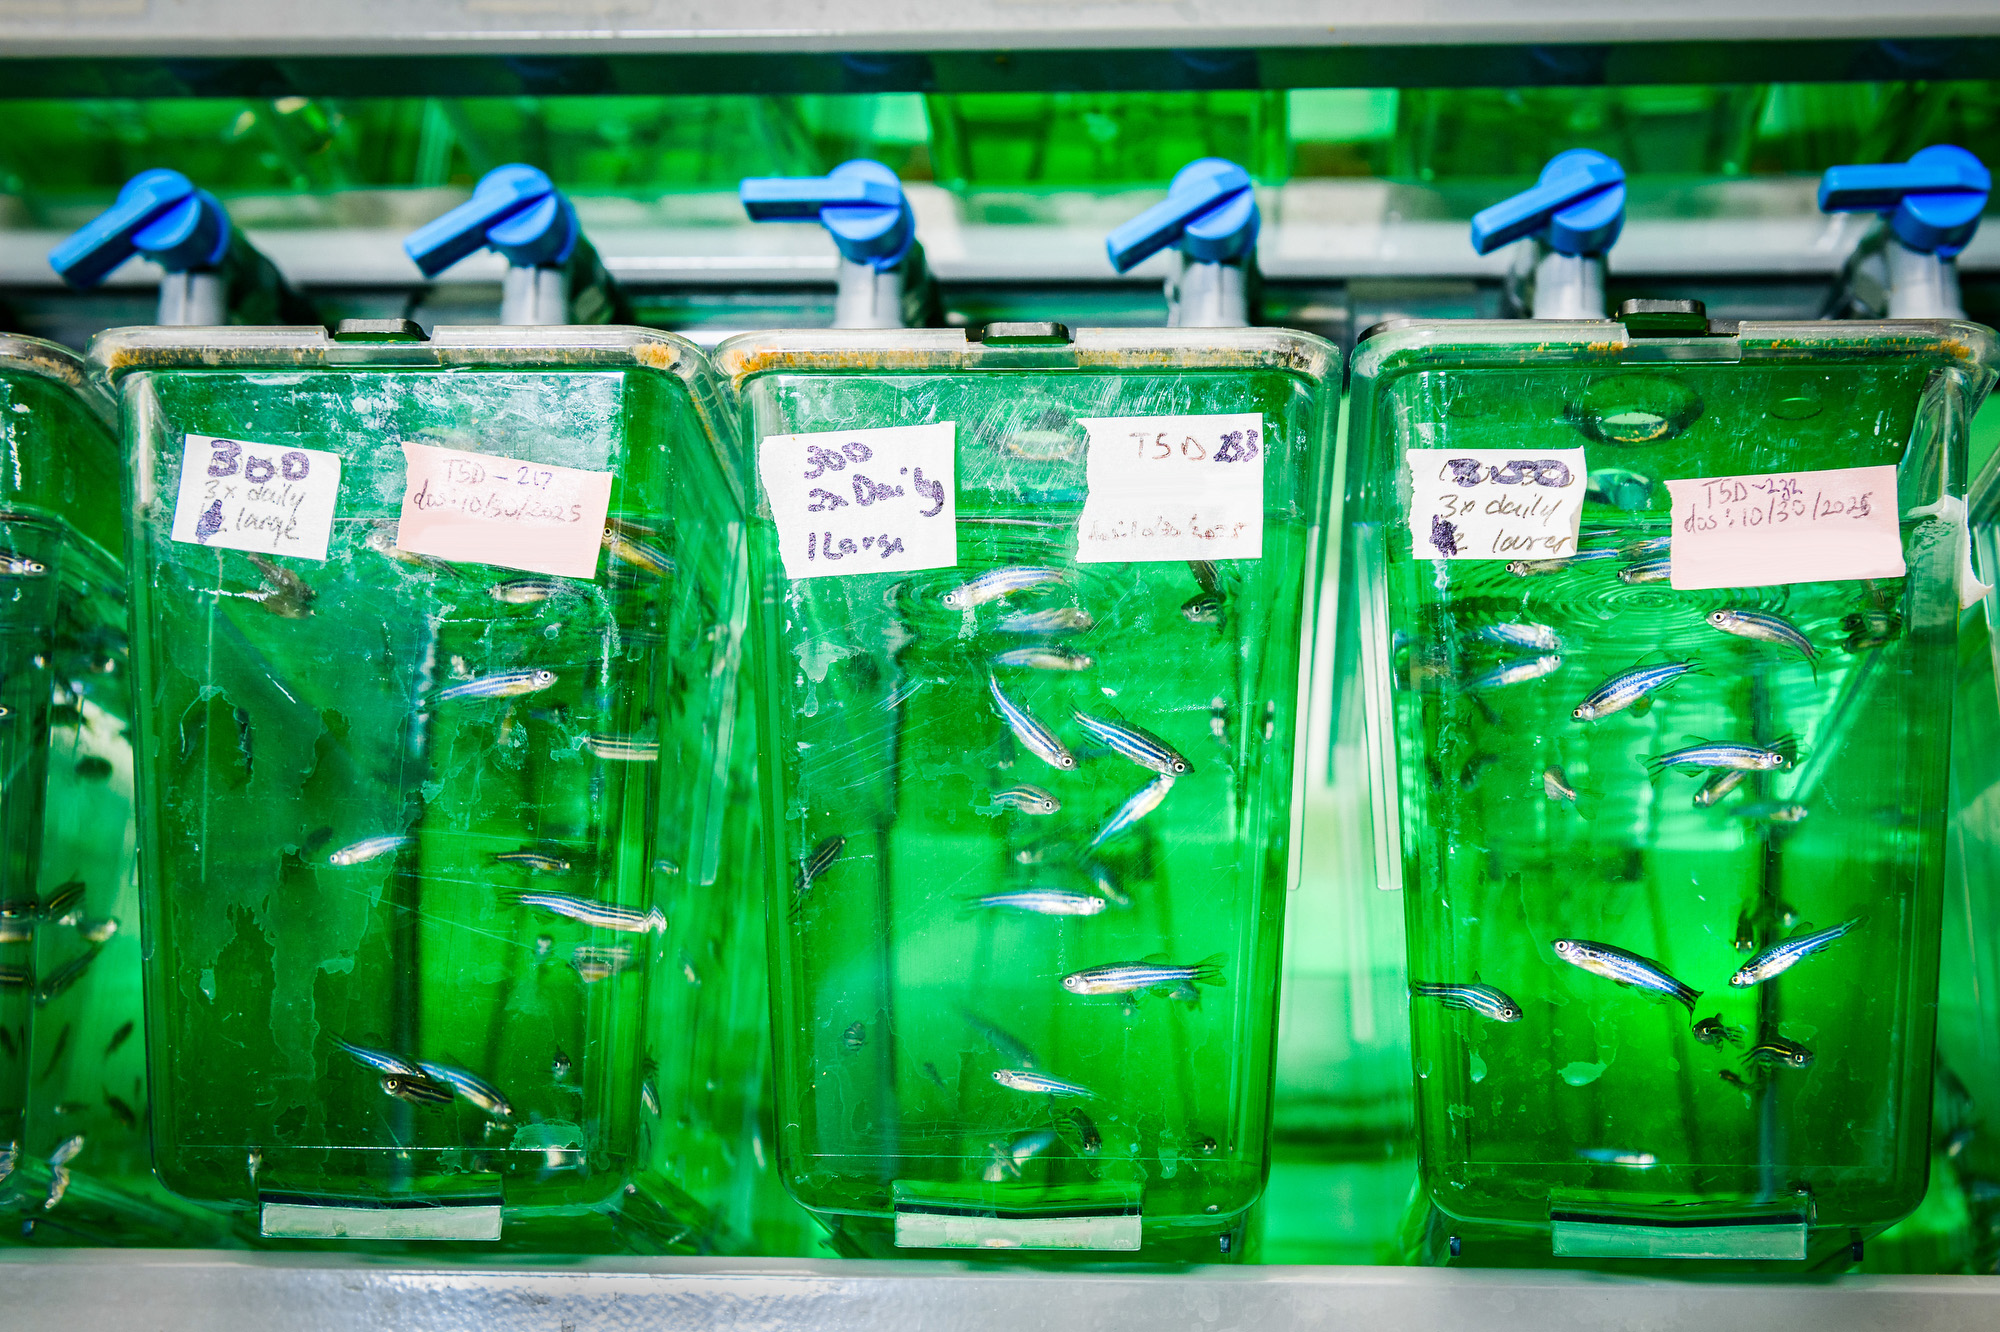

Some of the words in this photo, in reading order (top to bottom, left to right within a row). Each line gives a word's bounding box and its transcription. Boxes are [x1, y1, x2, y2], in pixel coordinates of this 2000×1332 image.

[208, 440, 310, 484] 300
[804, 442, 873, 480] 300
[247, 482, 306, 520] daily
[853, 467, 945, 517] Daily
[1485, 494, 1562, 526] daily
[236, 507, 299, 547] large
